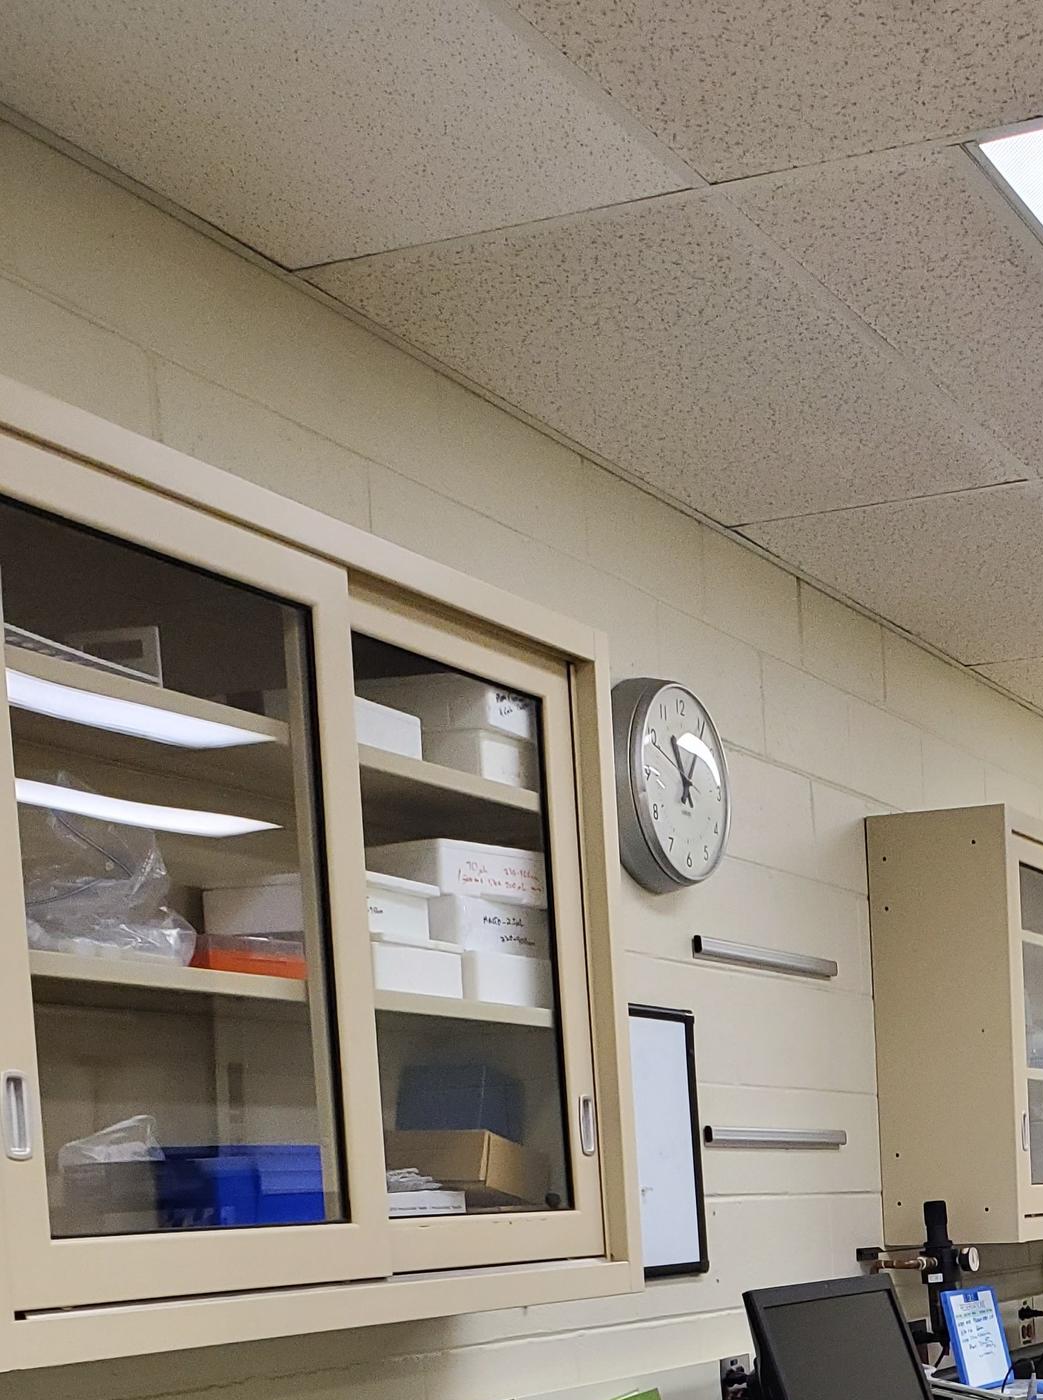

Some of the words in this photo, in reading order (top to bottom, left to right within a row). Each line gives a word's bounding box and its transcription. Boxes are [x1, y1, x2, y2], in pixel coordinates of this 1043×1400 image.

[659, 703, 668, 721] 11
[675, 698, 686, 717] 12
[652, 803, 659, 820] 8
[713, 822, 719, 836] 4
[668, 836, 675, 853] 7
[686, 851, 693, 867] 6
[703, 845, 710, 862] 5
